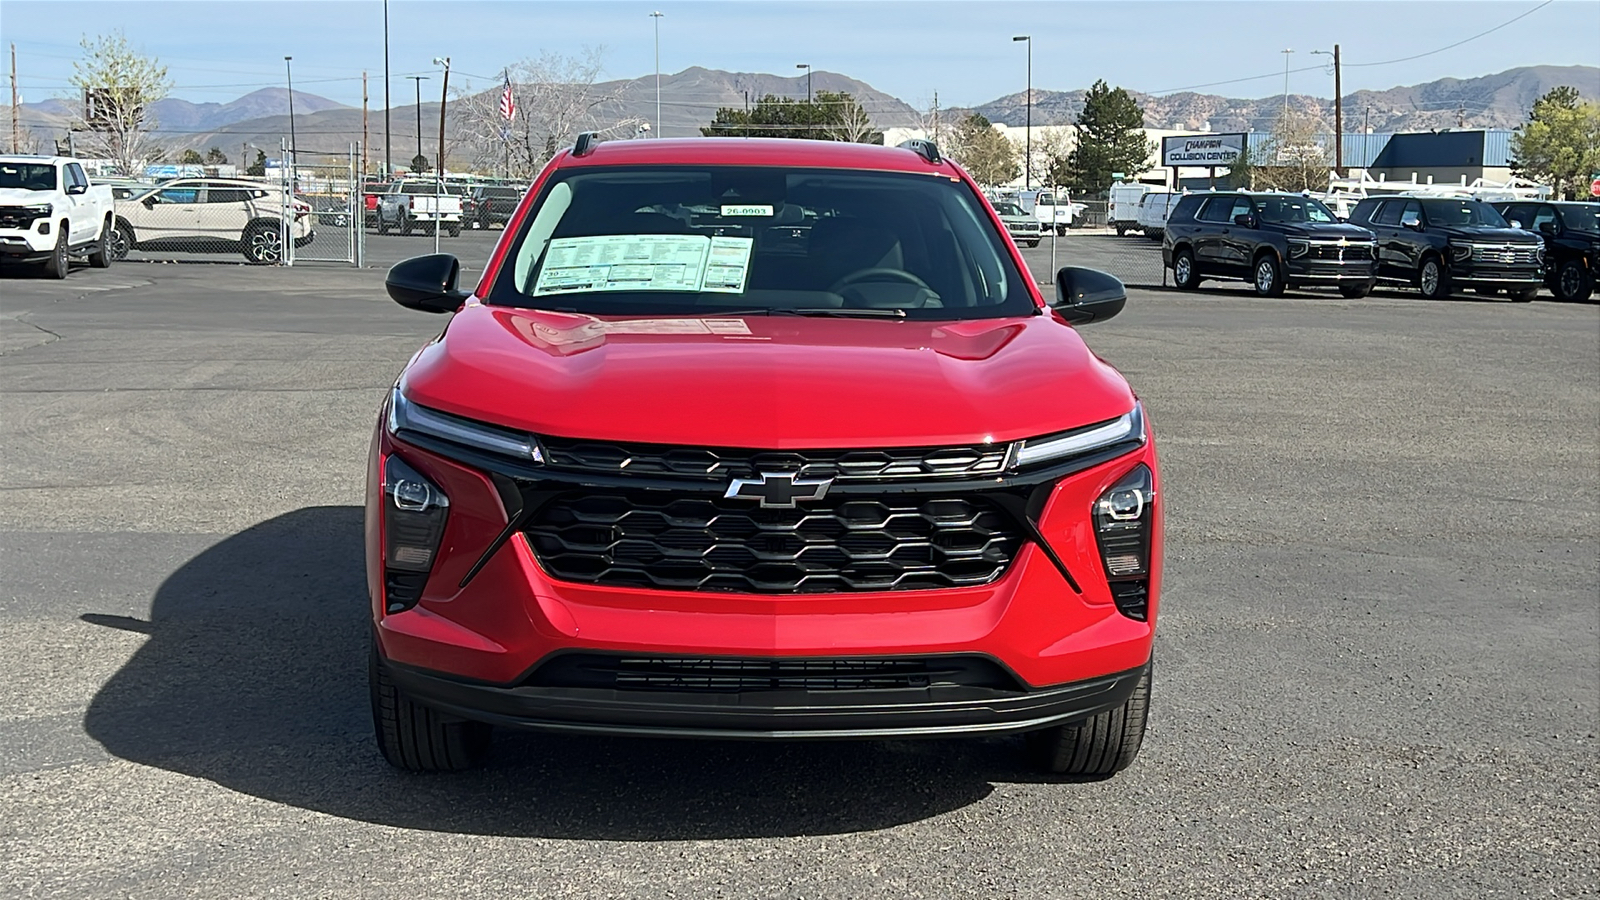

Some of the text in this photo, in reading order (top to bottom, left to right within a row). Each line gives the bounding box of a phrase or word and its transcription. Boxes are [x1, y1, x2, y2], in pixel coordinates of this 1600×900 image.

[1185, 140, 1222, 152] CHAMPION
[1170, 151, 1237, 161] COLLISION CENTER
